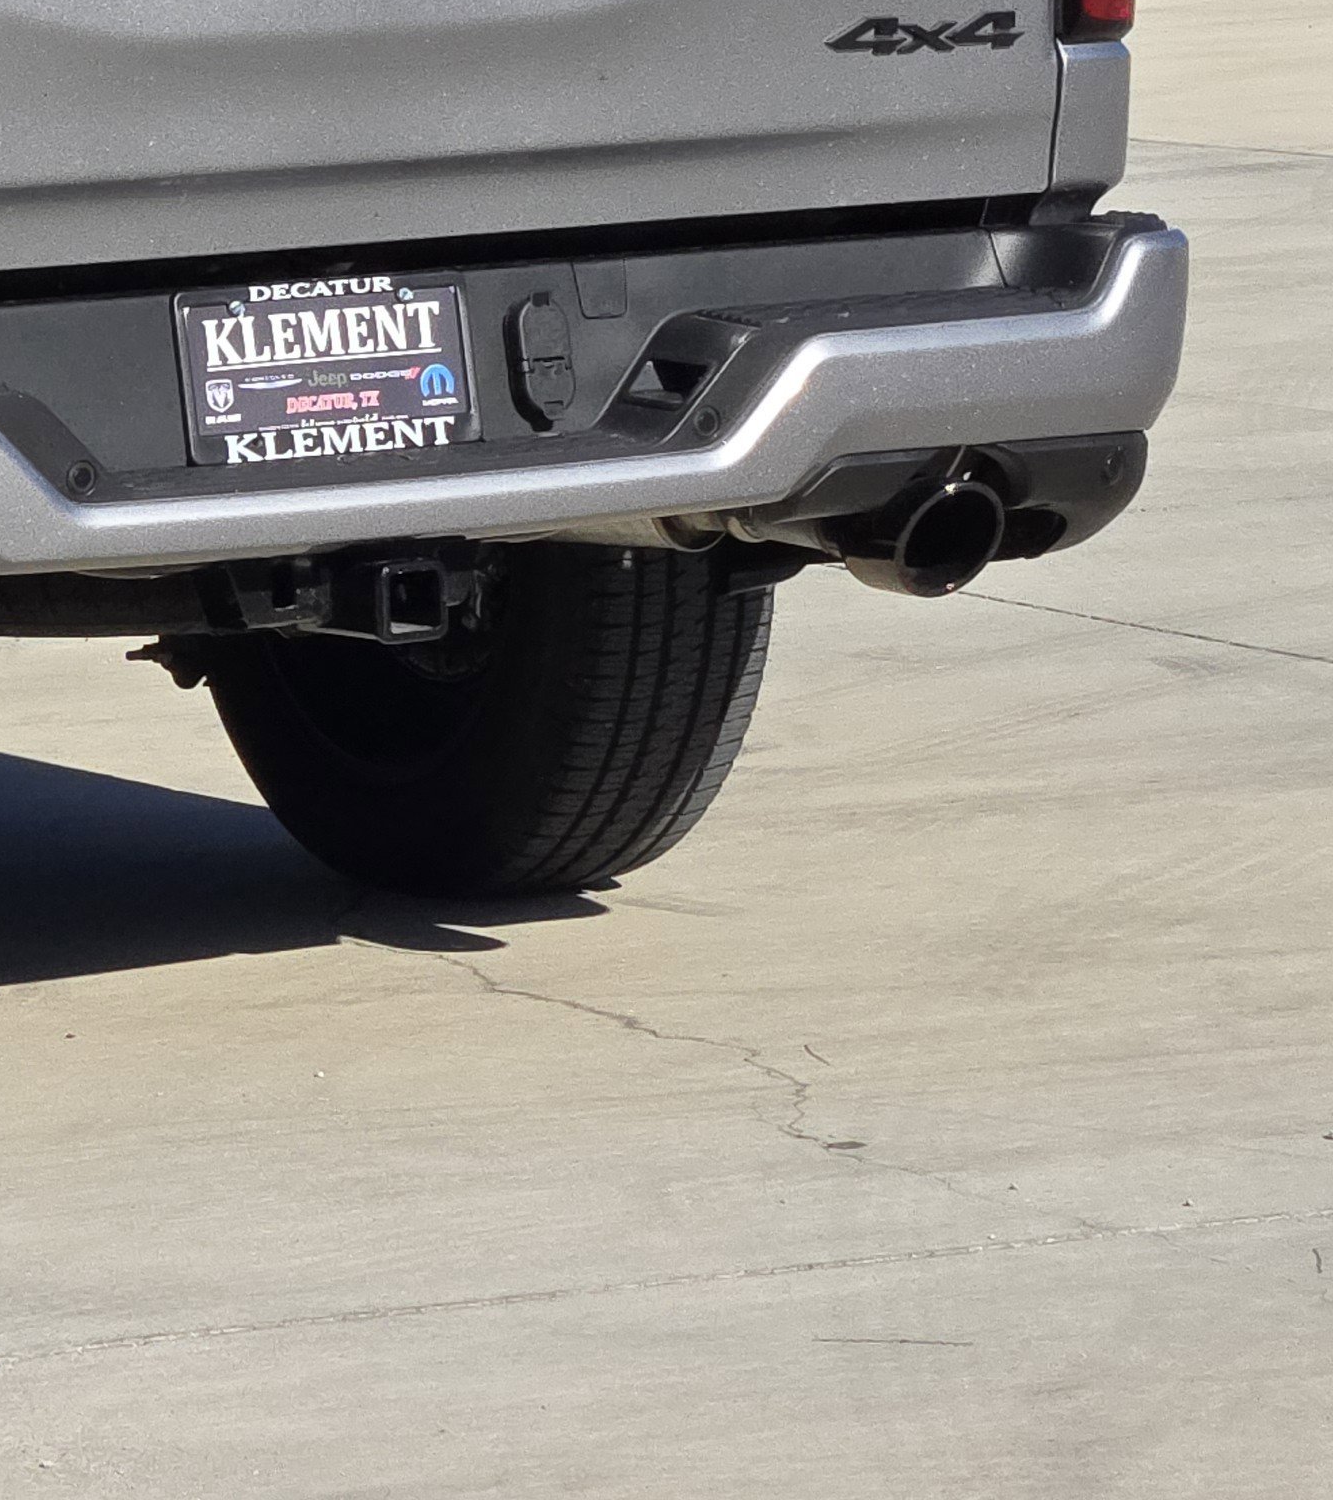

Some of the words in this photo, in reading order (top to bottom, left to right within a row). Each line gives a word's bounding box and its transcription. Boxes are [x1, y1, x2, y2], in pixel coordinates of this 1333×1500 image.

[823, 10, 1025, 56] 4x4
[248, 276, 393, 302] DECATUR
[202, 300, 440, 367] KLEMENT
[308, 369, 348, 388] Jeep
[285, 391, 357, 414] DECATUR,
[359, 390, 380, 408] TX
[224, 416, 455, 465] KLEMENT
